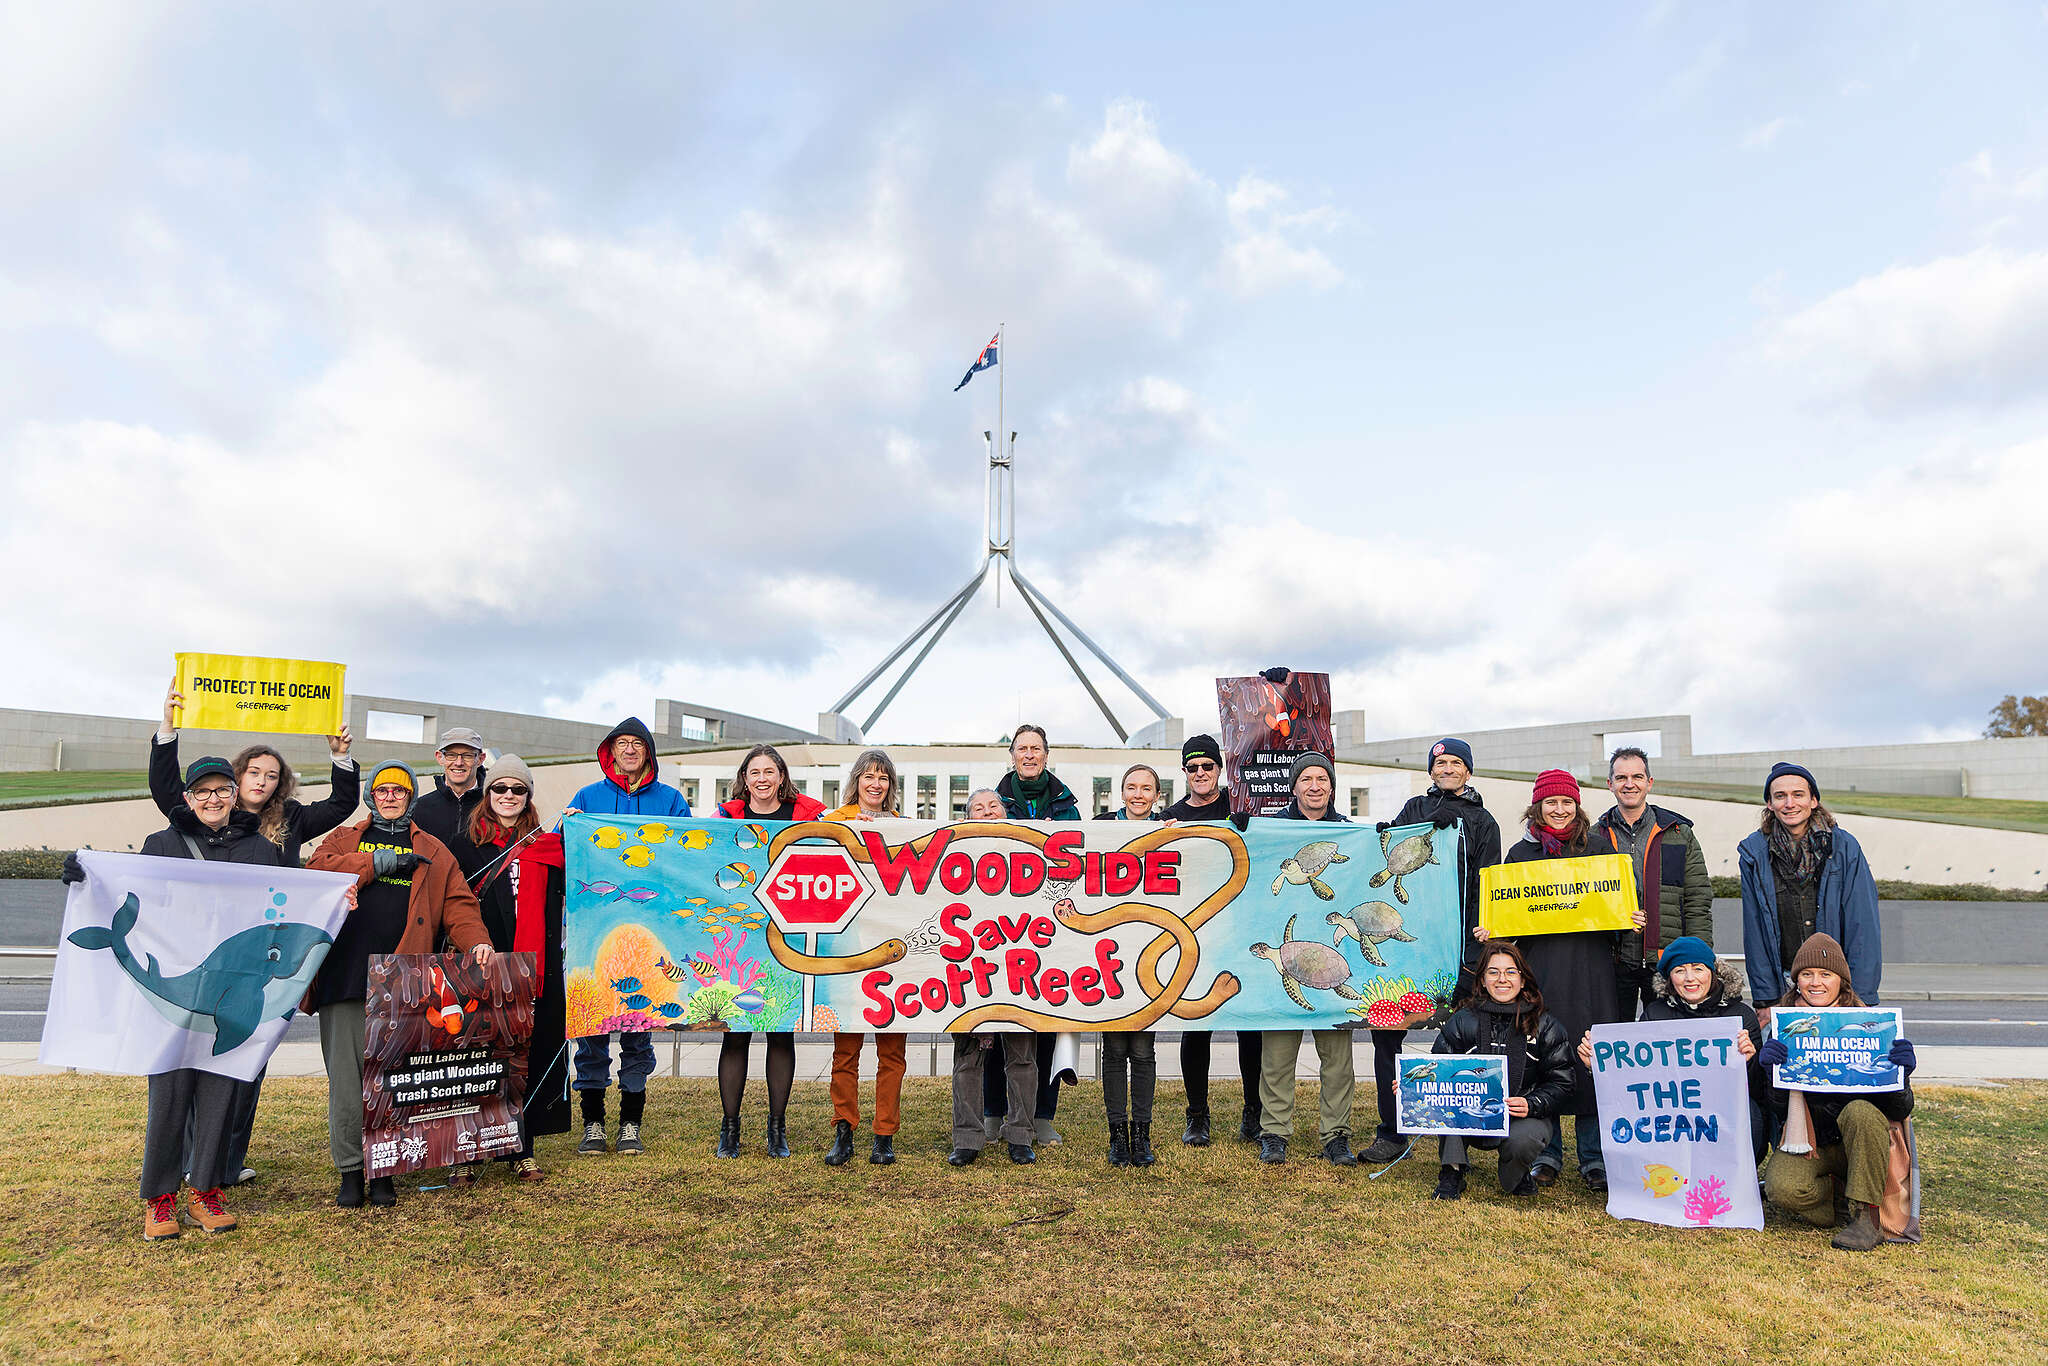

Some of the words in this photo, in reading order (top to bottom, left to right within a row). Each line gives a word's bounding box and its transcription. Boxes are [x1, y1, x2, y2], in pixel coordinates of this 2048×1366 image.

[193, 677, 256, 695] PROTECT
[260, 681, 285, 697] THE
[289, 683, 331, 699] OCEAN
[236, 701, 291, 711] GREENPEACE
[1256, 753, 1272, 764] Will
[1273, 753, 1295, 764] Labor
[1244, 770, 1259, 780] gas
[1260, 769, 1281, 780] giant
[1251, 783, 1272, 793] trash
[1273, 783, 1290, 793] Scot
[776, 874, 856, 901] STOP
[1524, 881, 1590, 898] SANCTUARY
[1594, 879, 1621, 893] NOW
[1528, 902, 1580, 913] GREENPEACE
[940, 902, 1056, 962] Save
[861, 956, 999, 1029] Scott
[1005, 938, 1124, 1007] Reef
[1795, 1036, 1800, 1049] I
[1802, 1036, 1820, 1049] AM
[1822, 1037, 1839, 1050] AN
[1841, 1037, 1880, 1050] OCEAN
[410, 1055, 433, 1066] Will
[436, 1052, 468, 1063] Labor
[471, 1050, 488, 1059] let
[1593, 1038, 1733, 1073] PROTECT
[1805, 1051, 1872, 1064] PROTECTOR
[390, 1073, 411, 1087] gas
[414, 1069, 445, 1084] giant
[447, 1062, 503, 1079] Woodside
[397, 1088, 428, 1102] trash
[431, 1084, 462, 1098] Scott
[464, 1079, 497, 1094] Reef?
[1416, 1081, 1420, 1093] I
[1421, 1081, 1437, 1094] AM
[1439, 1082, 1453, 1094] AN
[1455, 1082, 1488, 1095] OCEAN
[1626, 1078, 1702, 1111] THE
[1424, 1094, 1480, 1107] PROTECTOR
[1610, 1114, 1719, 1144] OCEAN
[371, 1140, 398, 1153] SAVE
[371, 1157, 399, 1170] REEF
